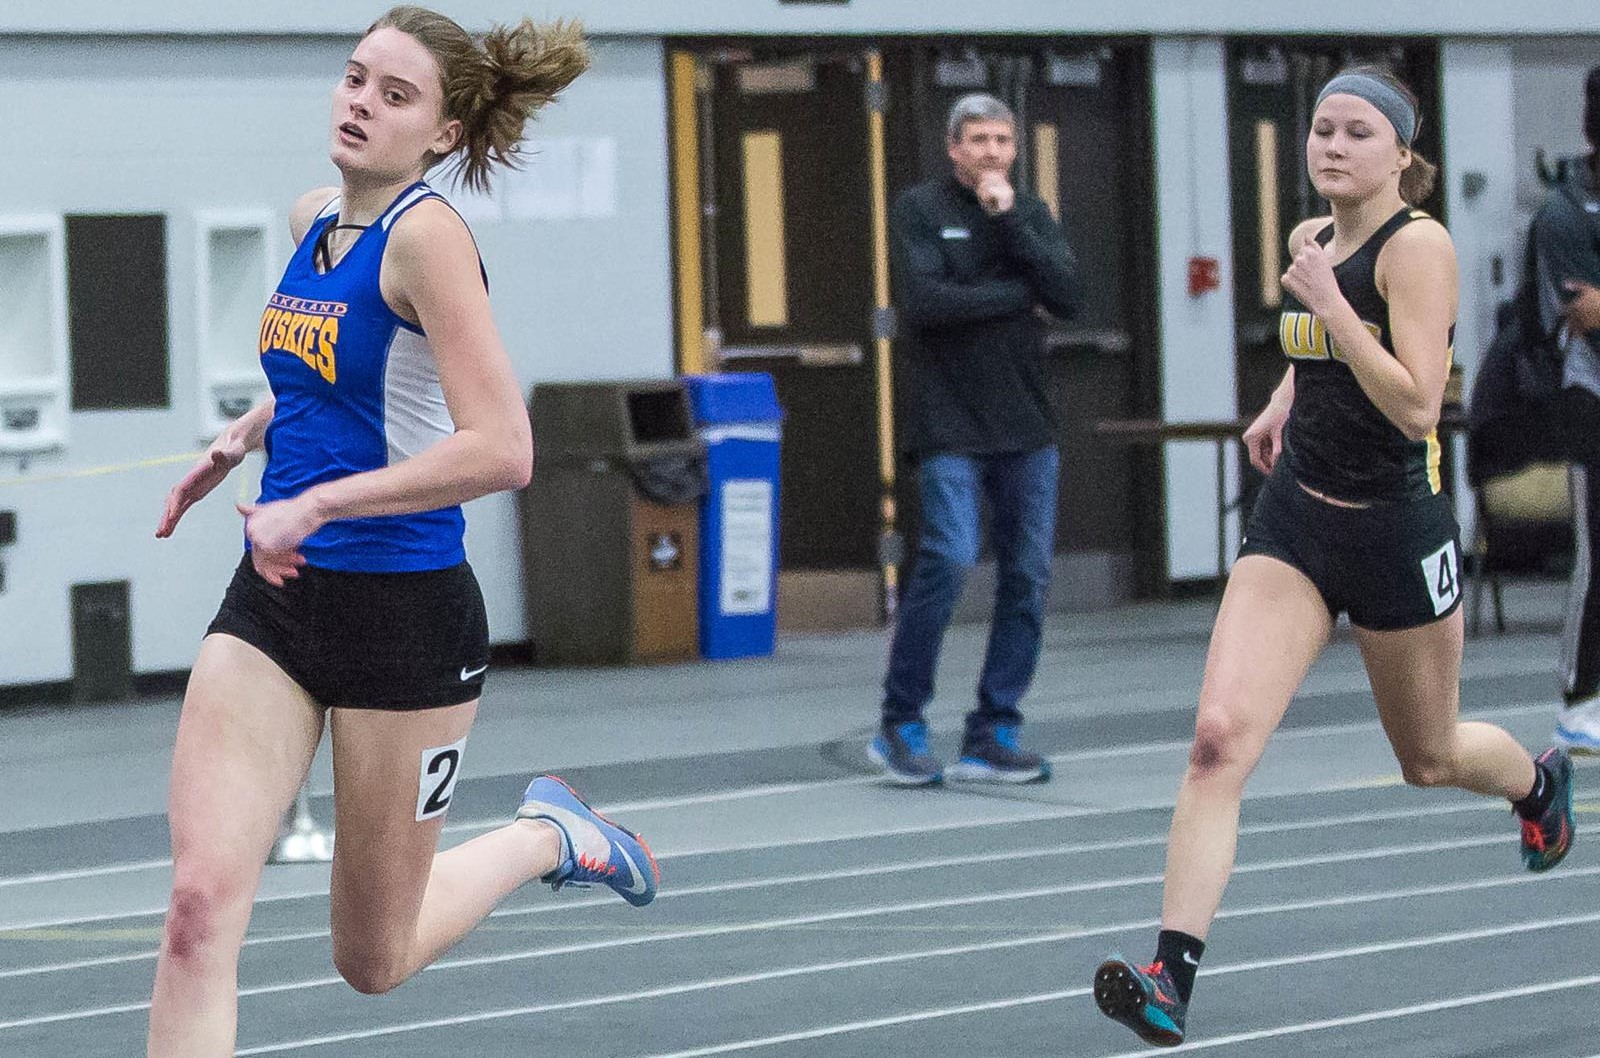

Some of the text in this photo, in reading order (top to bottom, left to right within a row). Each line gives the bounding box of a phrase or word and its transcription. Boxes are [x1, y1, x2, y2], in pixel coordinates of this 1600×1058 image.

[272, 294, 348, 314] AKELAND
[261, 307, 339, 385] USKIES
[1437, 550, 1455, 599] 4
[422, 749, 460, 815] 2
